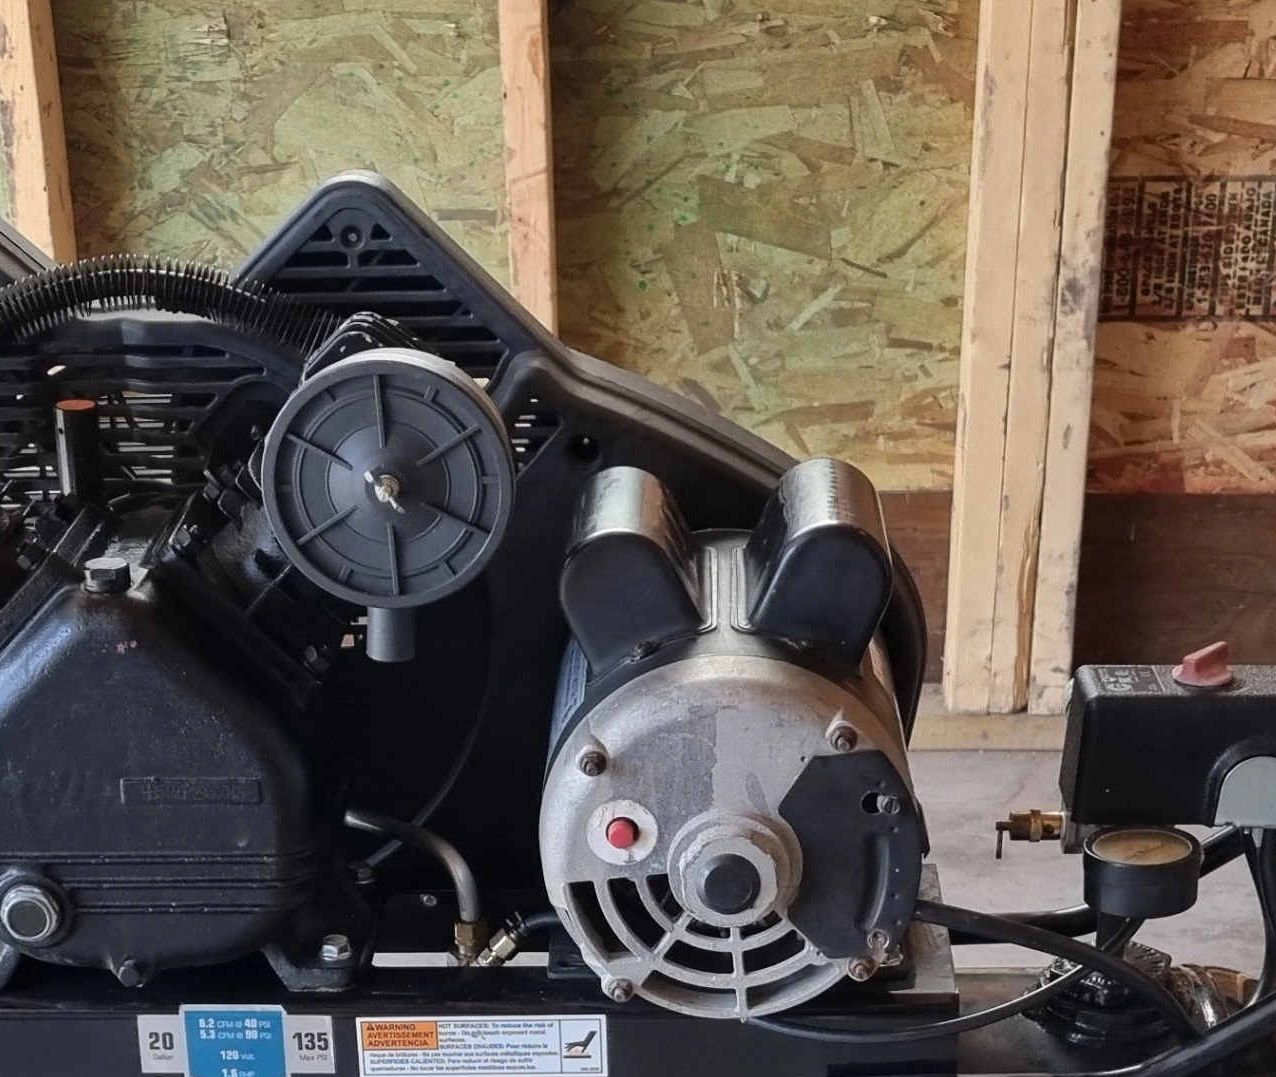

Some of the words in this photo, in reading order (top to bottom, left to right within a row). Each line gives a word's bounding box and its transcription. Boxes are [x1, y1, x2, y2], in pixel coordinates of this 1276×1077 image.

[1257, 190, 1272, 248] CANADA
[244, 1018, 257, 1028] 40
[375, 1023, 416, 1031] WARNING
[200, 1029, 215, 1039] 5.3
[245, 1030, 258, 1039] 90
[367, 1031, 434, 1039] AVERTISSEMENT
[148, 1031, 174, 1051] 20
[292, 1032, 329, 1051] 135
[367, 1039, 429, 1047] ADVERTENCIA
[153, 1053, 174, 1061] Gallon
[220, 1050, 239, 1060] 120
[221, 1068, 238, 1077] 1.6
